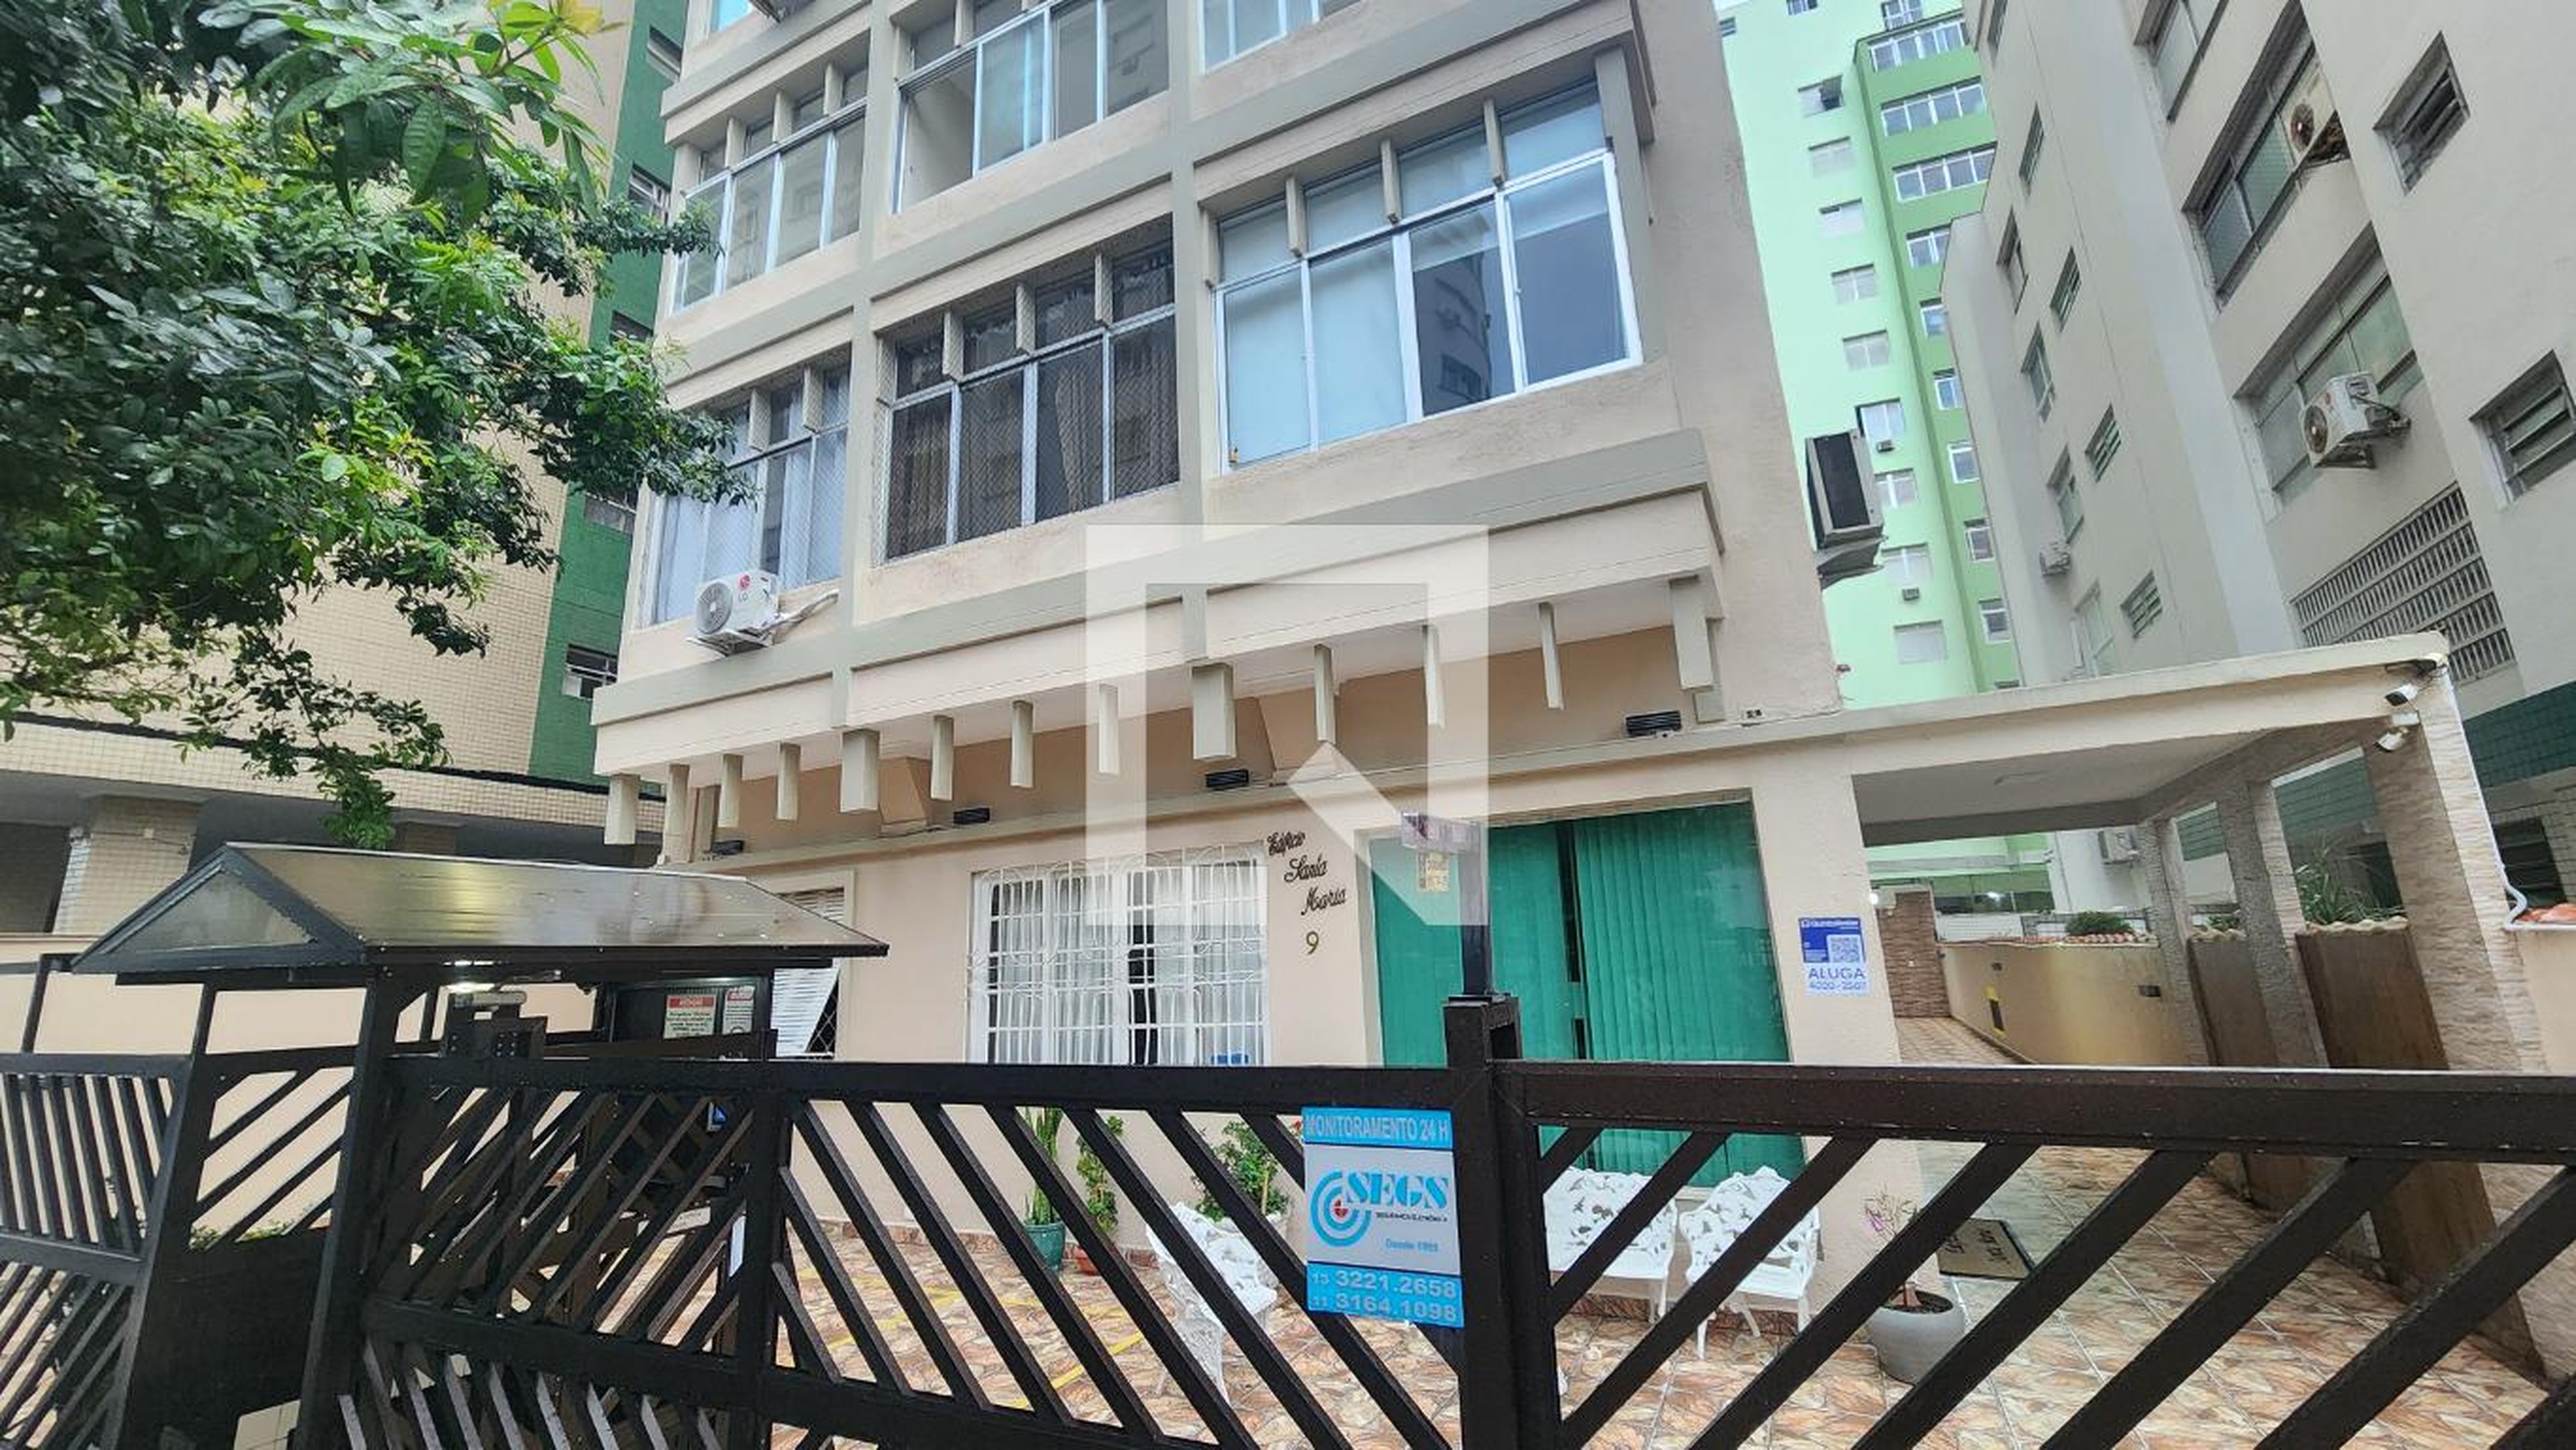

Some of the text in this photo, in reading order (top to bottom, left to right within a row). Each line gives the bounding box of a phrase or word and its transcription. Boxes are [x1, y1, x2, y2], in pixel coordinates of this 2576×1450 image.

[1283, 854, 1328, 883] Santa
[1301, 885, 1347, 915] Maria
[1305, 930, 1320, 955] 9
[1808, 967, 1866, 979] ALUGA
[1305, 1114, 1448, 1141] MONITORAMENTO 24 H
[1347, 1172, 1448, 1209] SEGS
[1335, 1270, 1457, 1299] 3221.2658
[1335, 1292, 1457, 1322] 3164.1098
